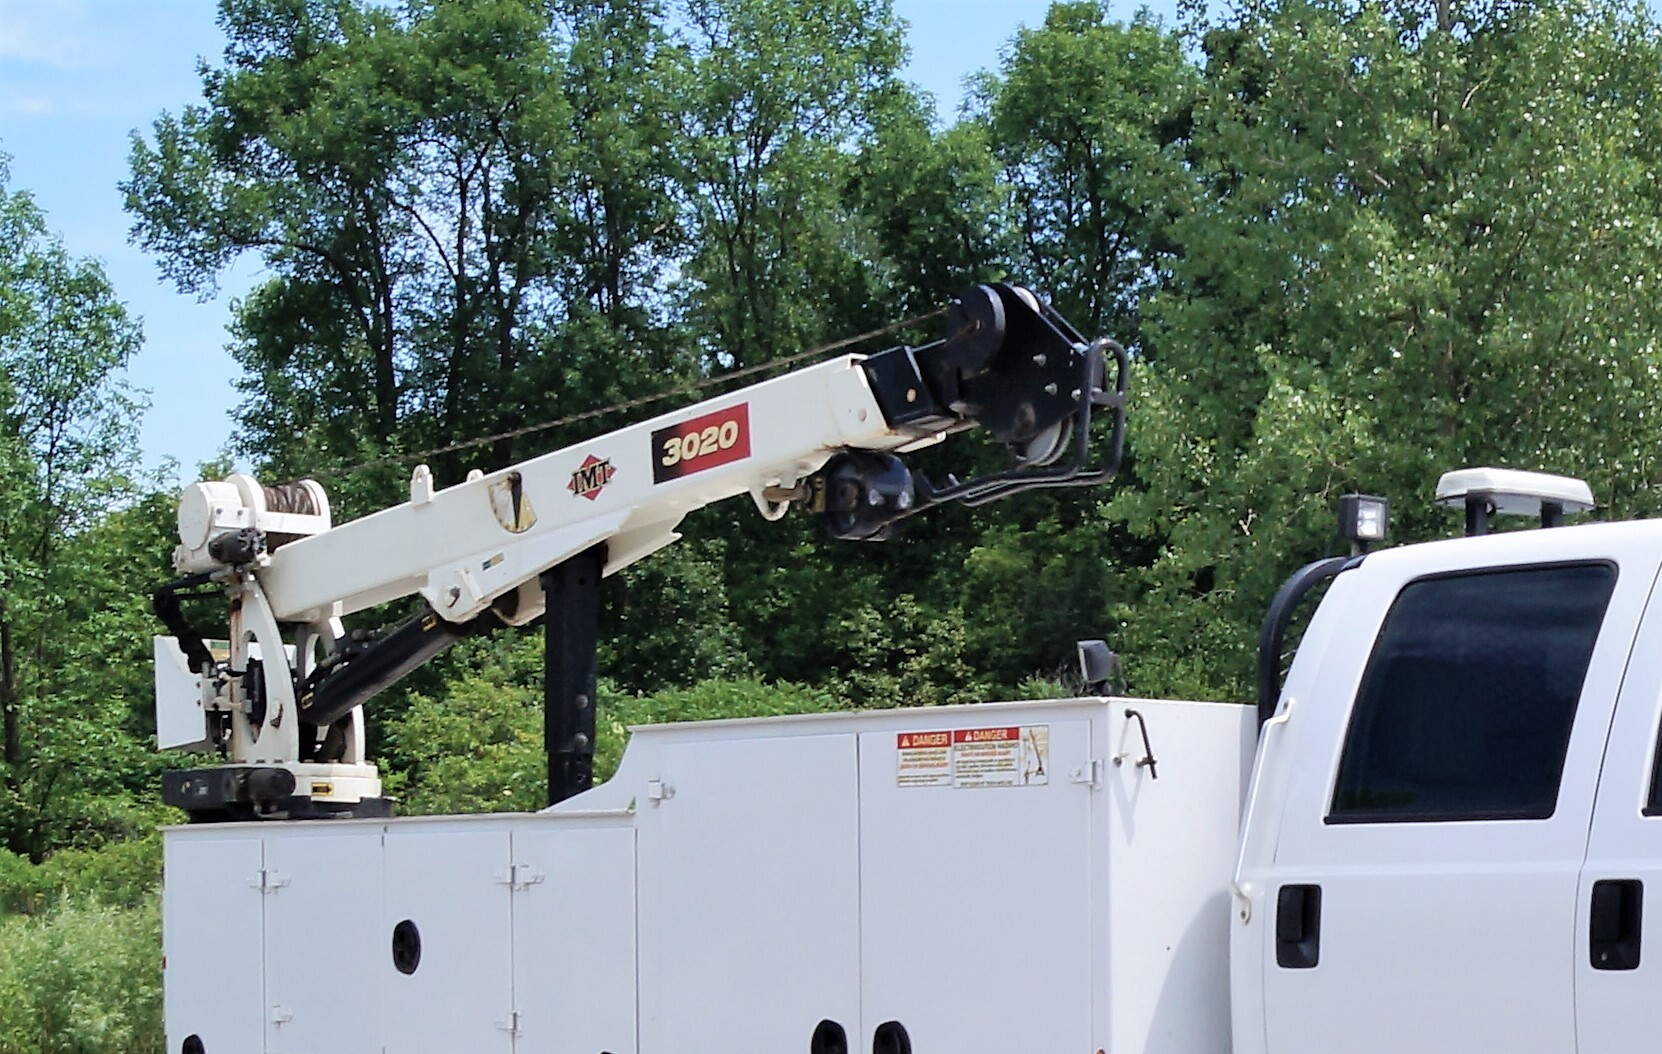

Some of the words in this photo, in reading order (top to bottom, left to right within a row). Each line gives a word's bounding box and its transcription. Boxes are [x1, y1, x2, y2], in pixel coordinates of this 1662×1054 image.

[661, 420, 739, 467] 3020
[572, 457, 611, 495] IMT
[912, 733, 948, 747] DANGER
[973, 729, 1008, 741] DANGER
